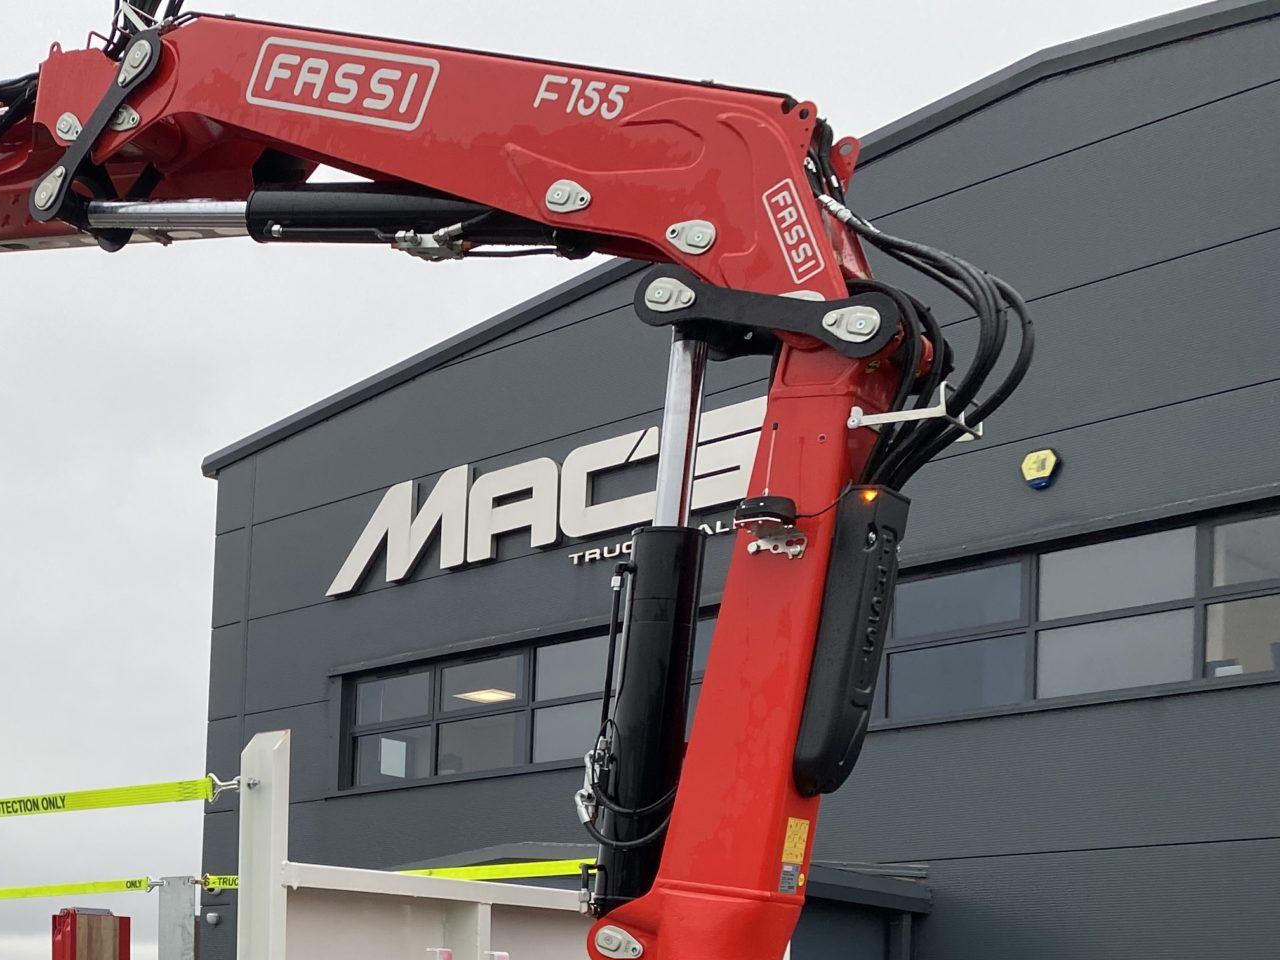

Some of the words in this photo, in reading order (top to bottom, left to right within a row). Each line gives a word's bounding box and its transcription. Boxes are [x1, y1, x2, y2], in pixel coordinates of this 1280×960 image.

[264, 53, 418, 114] FASSI
[533, 74, 630, 120] F155
[770, 190, 816, 273] FASSI
[568, 540, 634, 565] TRUC
[41, 795, 66, 810] ONLY
